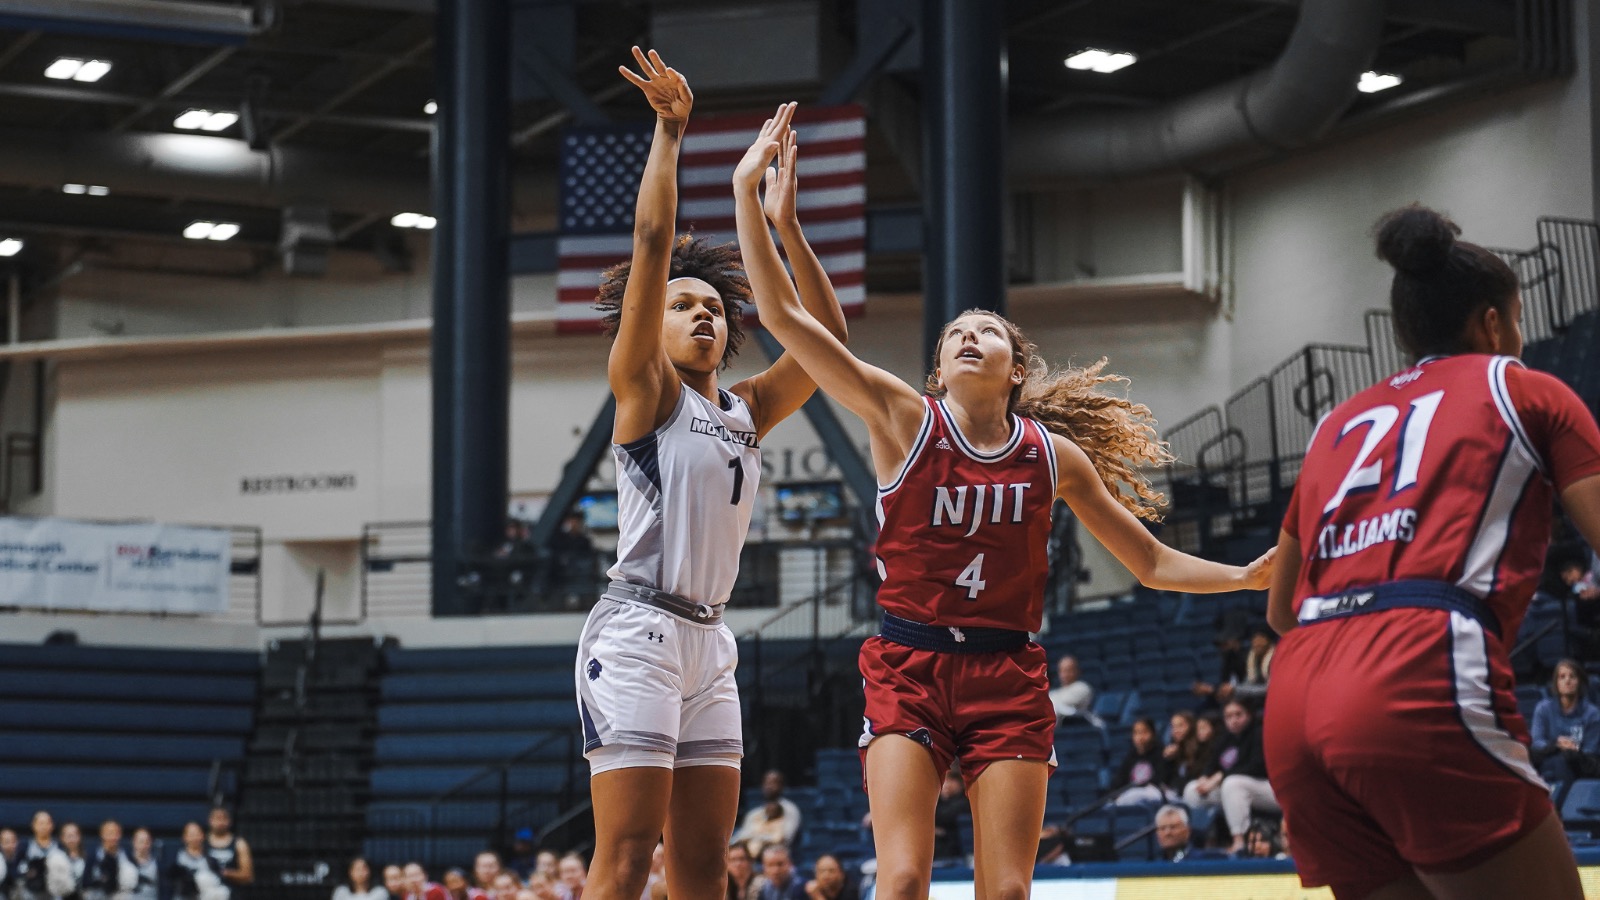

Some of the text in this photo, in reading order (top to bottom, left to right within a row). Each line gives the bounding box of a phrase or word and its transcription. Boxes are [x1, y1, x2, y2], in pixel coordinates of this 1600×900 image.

[727, 455, 744, 506] 1
[1321, 389, 1445, 521] 21
[932, 482, 1032, 538] NJIT
[1309, 507, 1417, 560] ILLIAMS
[954, 552, 986, 600] 4
